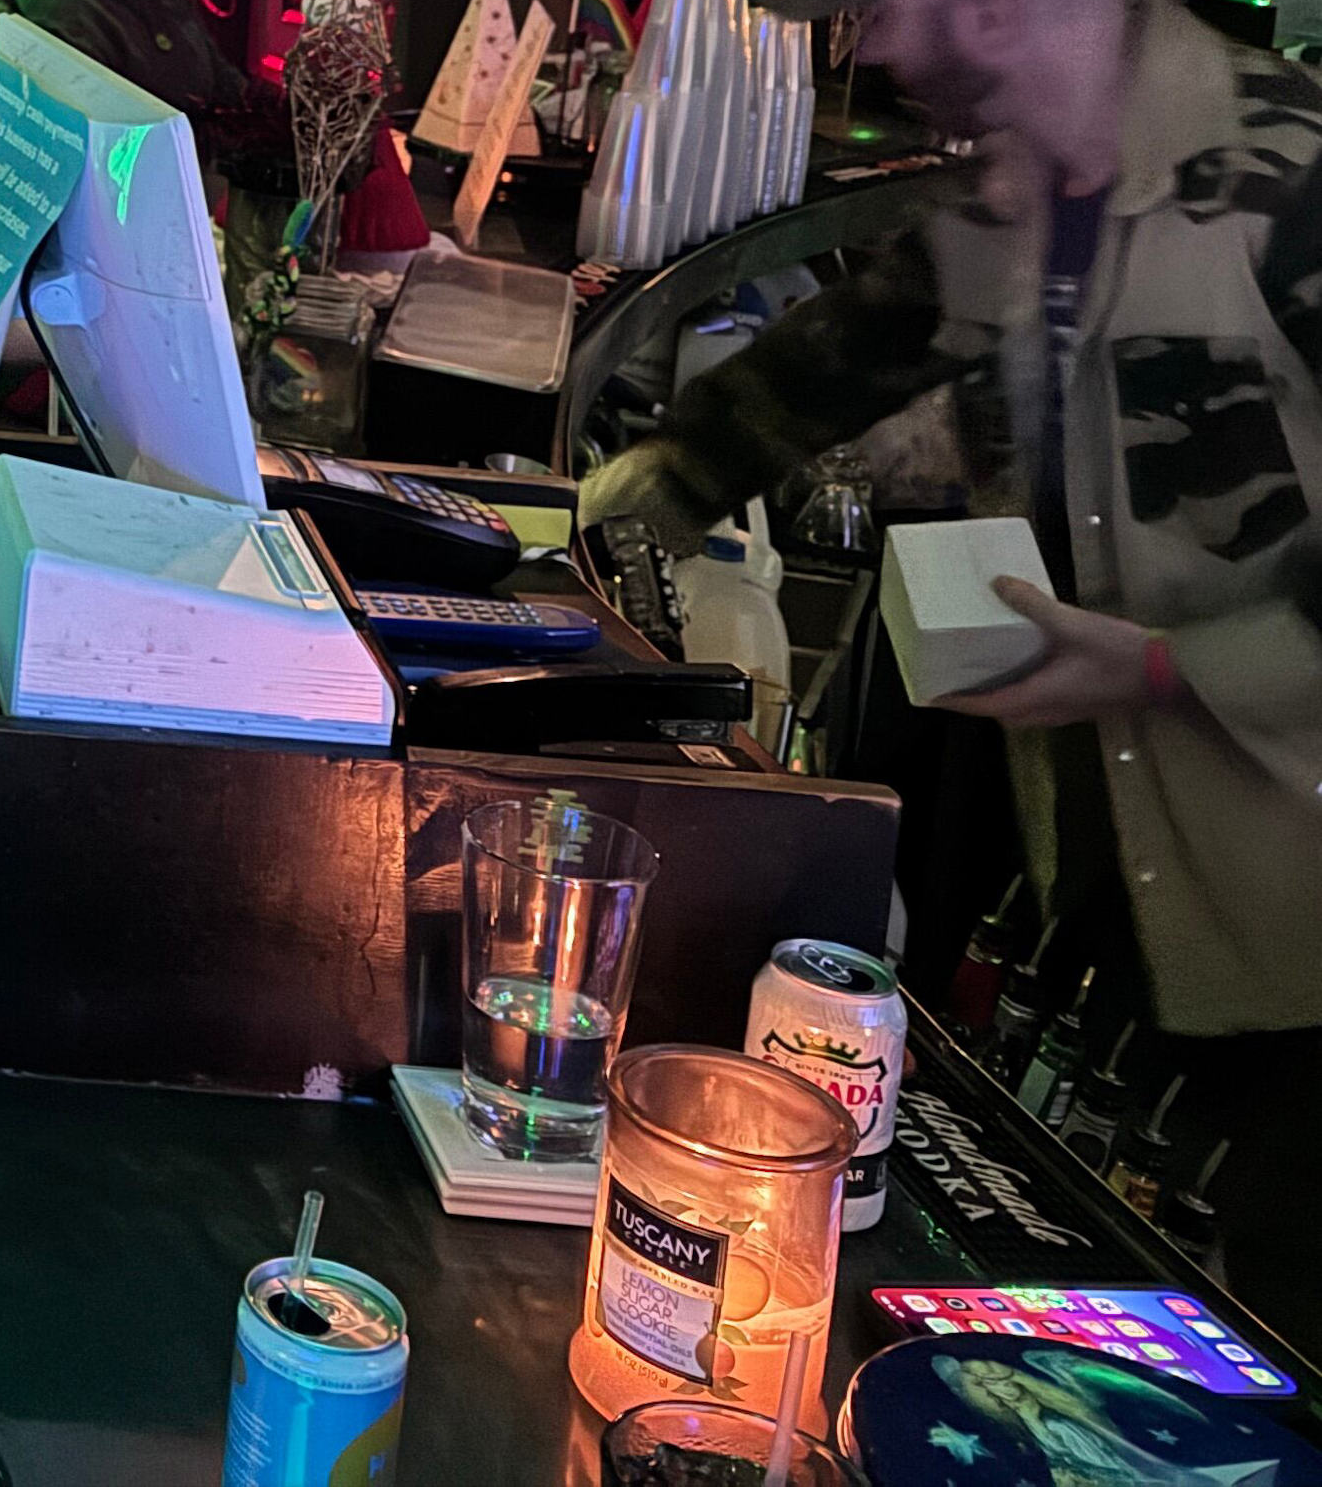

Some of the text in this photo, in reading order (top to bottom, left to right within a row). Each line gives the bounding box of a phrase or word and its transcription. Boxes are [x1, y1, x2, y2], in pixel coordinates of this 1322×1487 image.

[36, 147, 54, 172] has
[51, 161, 59, 176] a
[4, 169, 19, 189] be
[14, 180, 45, 207] added
[37, 195, 51, 214] to
[895, 1107, 995, 1221] VODKA
[898, 1089, 1093, 1248] Handmade
[614, 1199, 710, 1266] TUSCANY
[624, 1230, 691, 1269] CANDLE
[621, 1283, 673, 1320] SUGAR
[622, 1267, 680, 1310] LEMON
[618, 1297, 679, 1341] COOKIE
[625, 1320, 669, 1349] ESSENTIAL
